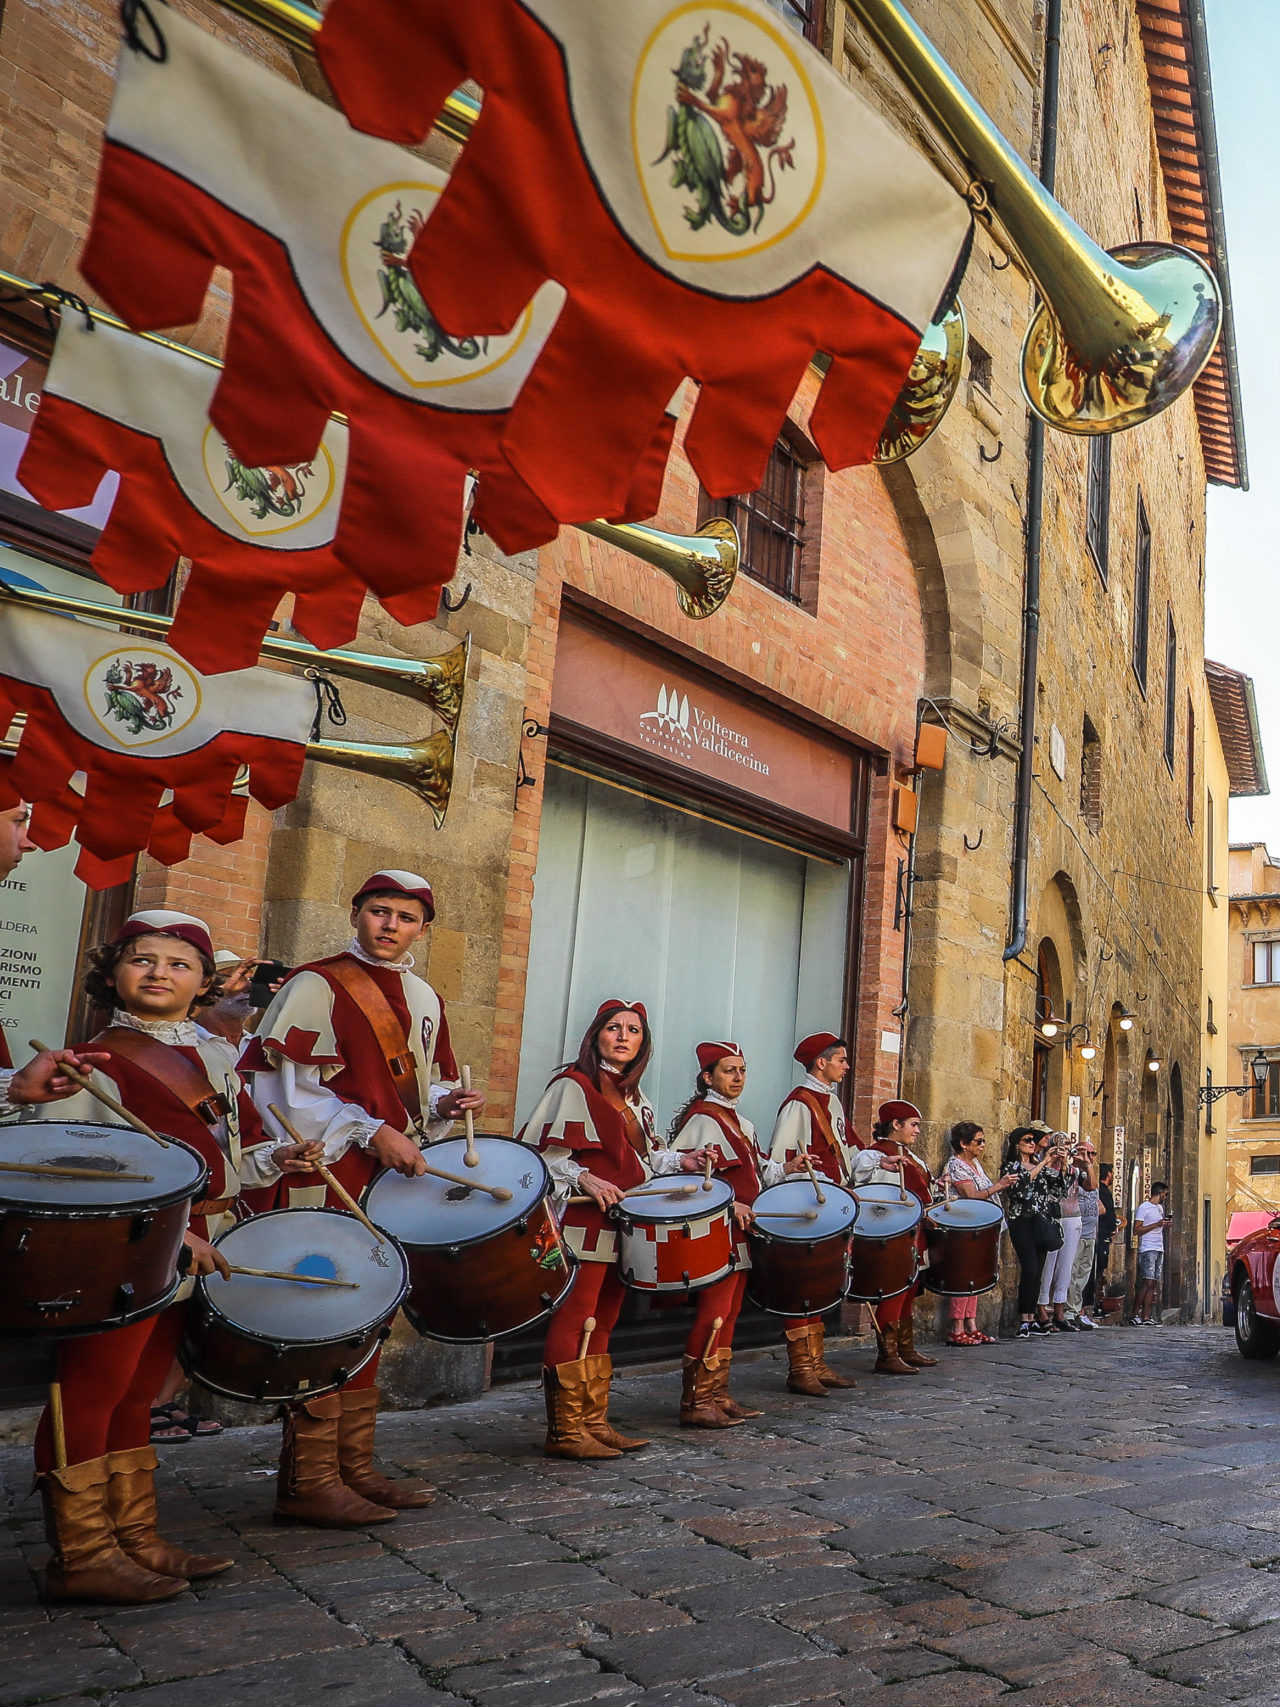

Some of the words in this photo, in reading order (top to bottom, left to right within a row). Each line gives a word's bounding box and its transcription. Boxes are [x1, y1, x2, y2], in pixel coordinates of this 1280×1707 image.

[693, 706, 749, 749] Volterra
[691, 725, 770, 776] Valdicecina
[0, 948, 37, 962] ZIONI
[1115, 1127, 1123, 1155] GELATO
[1114, 1157, 1122, 1206] ARTIGIANALE
